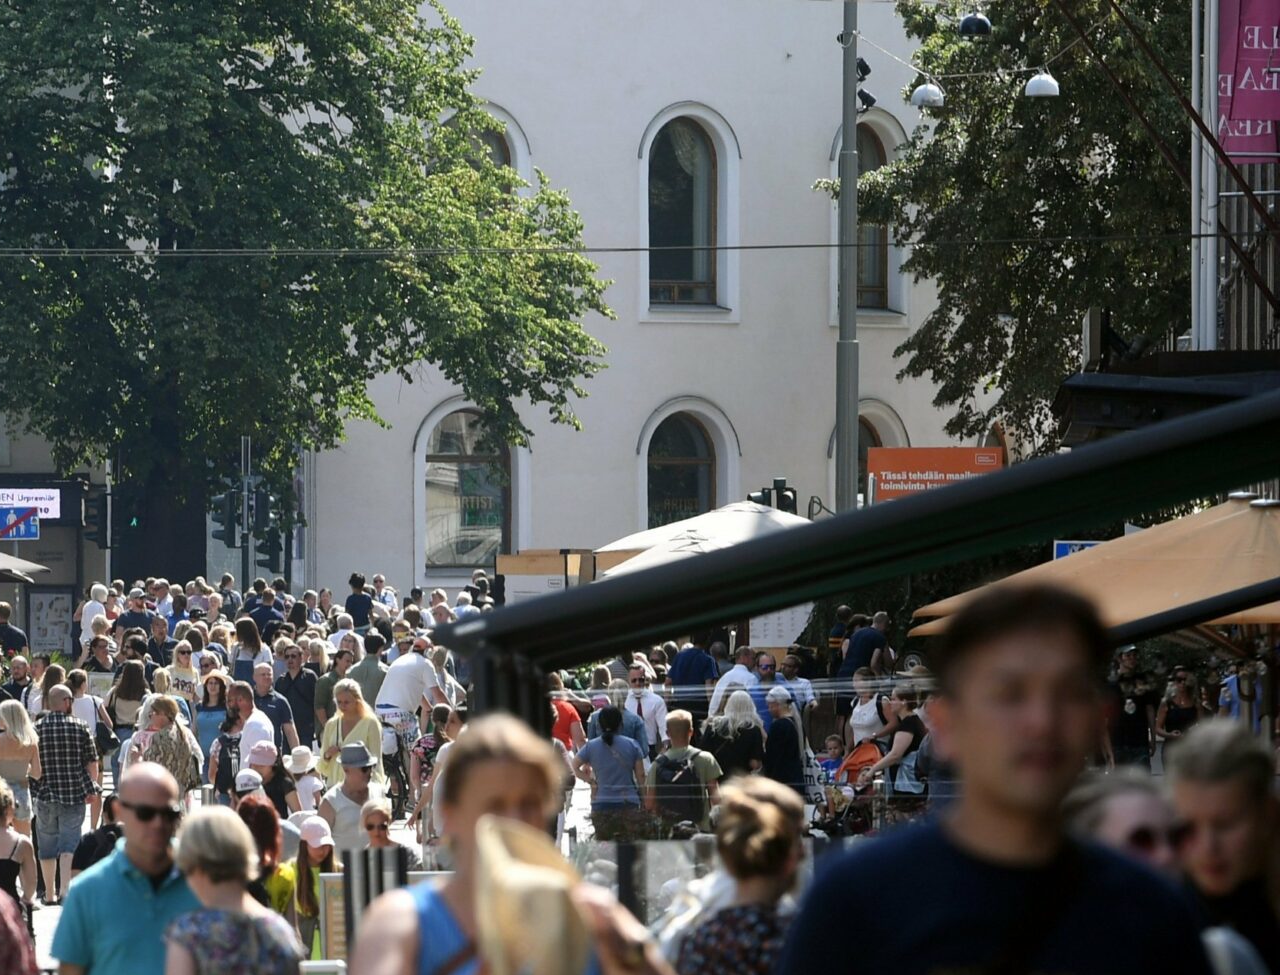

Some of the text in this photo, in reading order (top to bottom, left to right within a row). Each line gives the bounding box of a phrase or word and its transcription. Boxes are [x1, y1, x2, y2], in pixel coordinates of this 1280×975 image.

[880, 471, 907, 480] Tässä
[908, 471, 945, 480] tehdään
[880, 482, 926, 491] toimivinta
